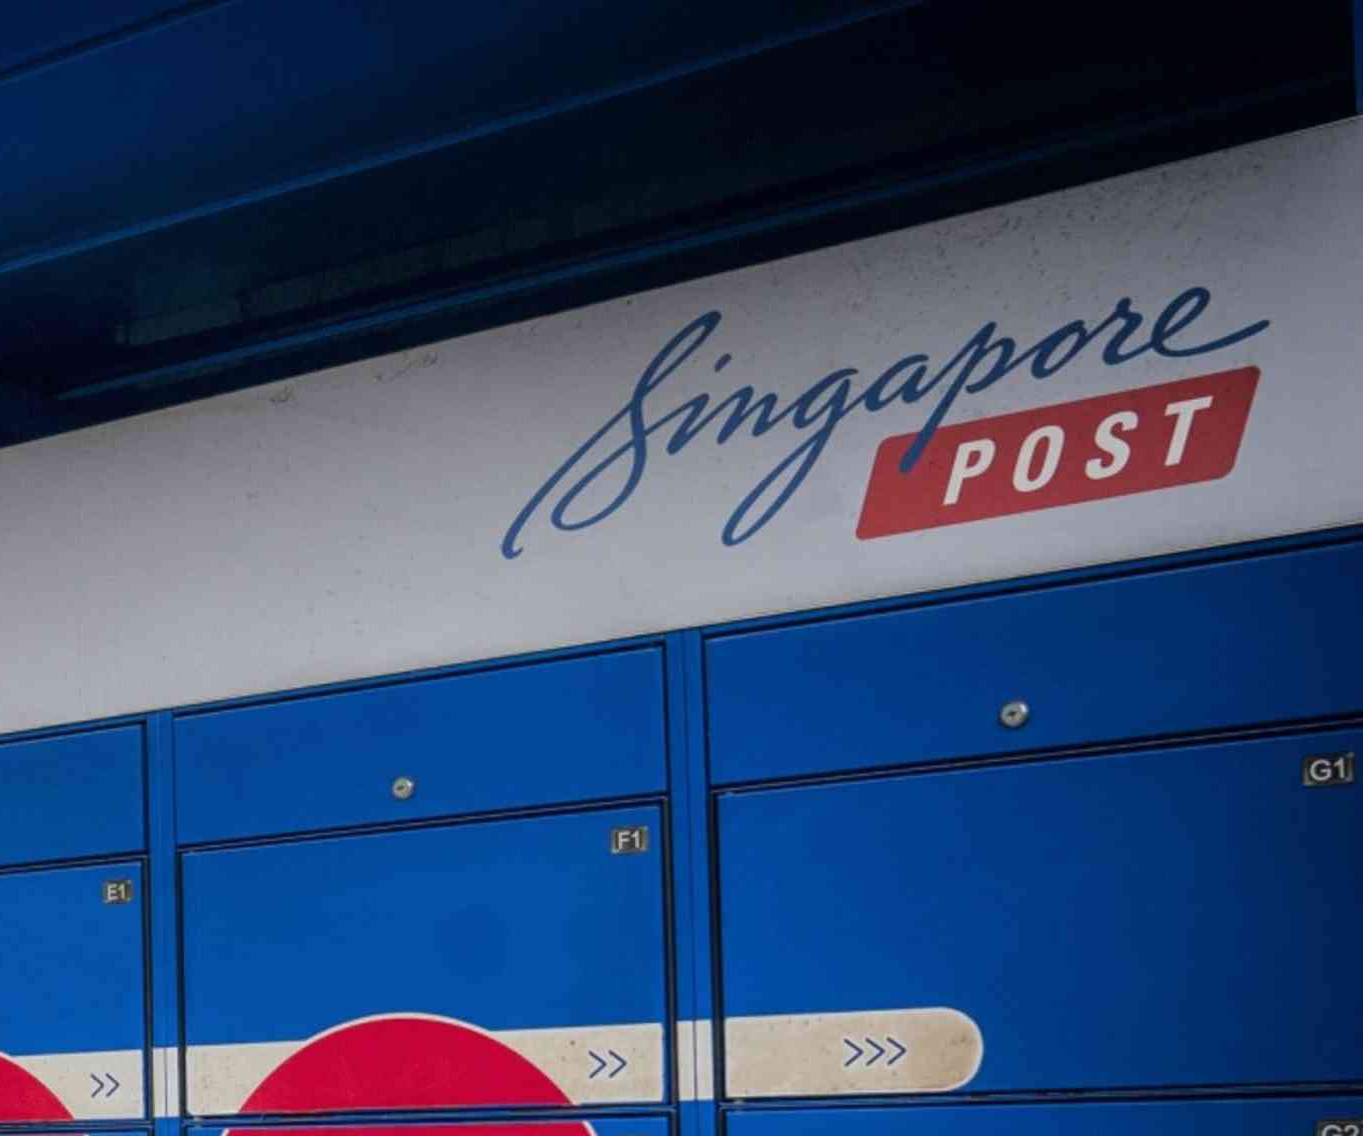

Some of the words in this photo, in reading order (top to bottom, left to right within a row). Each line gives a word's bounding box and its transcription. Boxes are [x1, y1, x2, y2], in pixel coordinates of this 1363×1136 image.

[501, 286, 1271, 560] Singapore
[943, 395, 1213, 507] POST
[1309, 758, 1347, 780] G1
[618, 831, 640, 849] F1
[107, 884, 125, 900] E1
